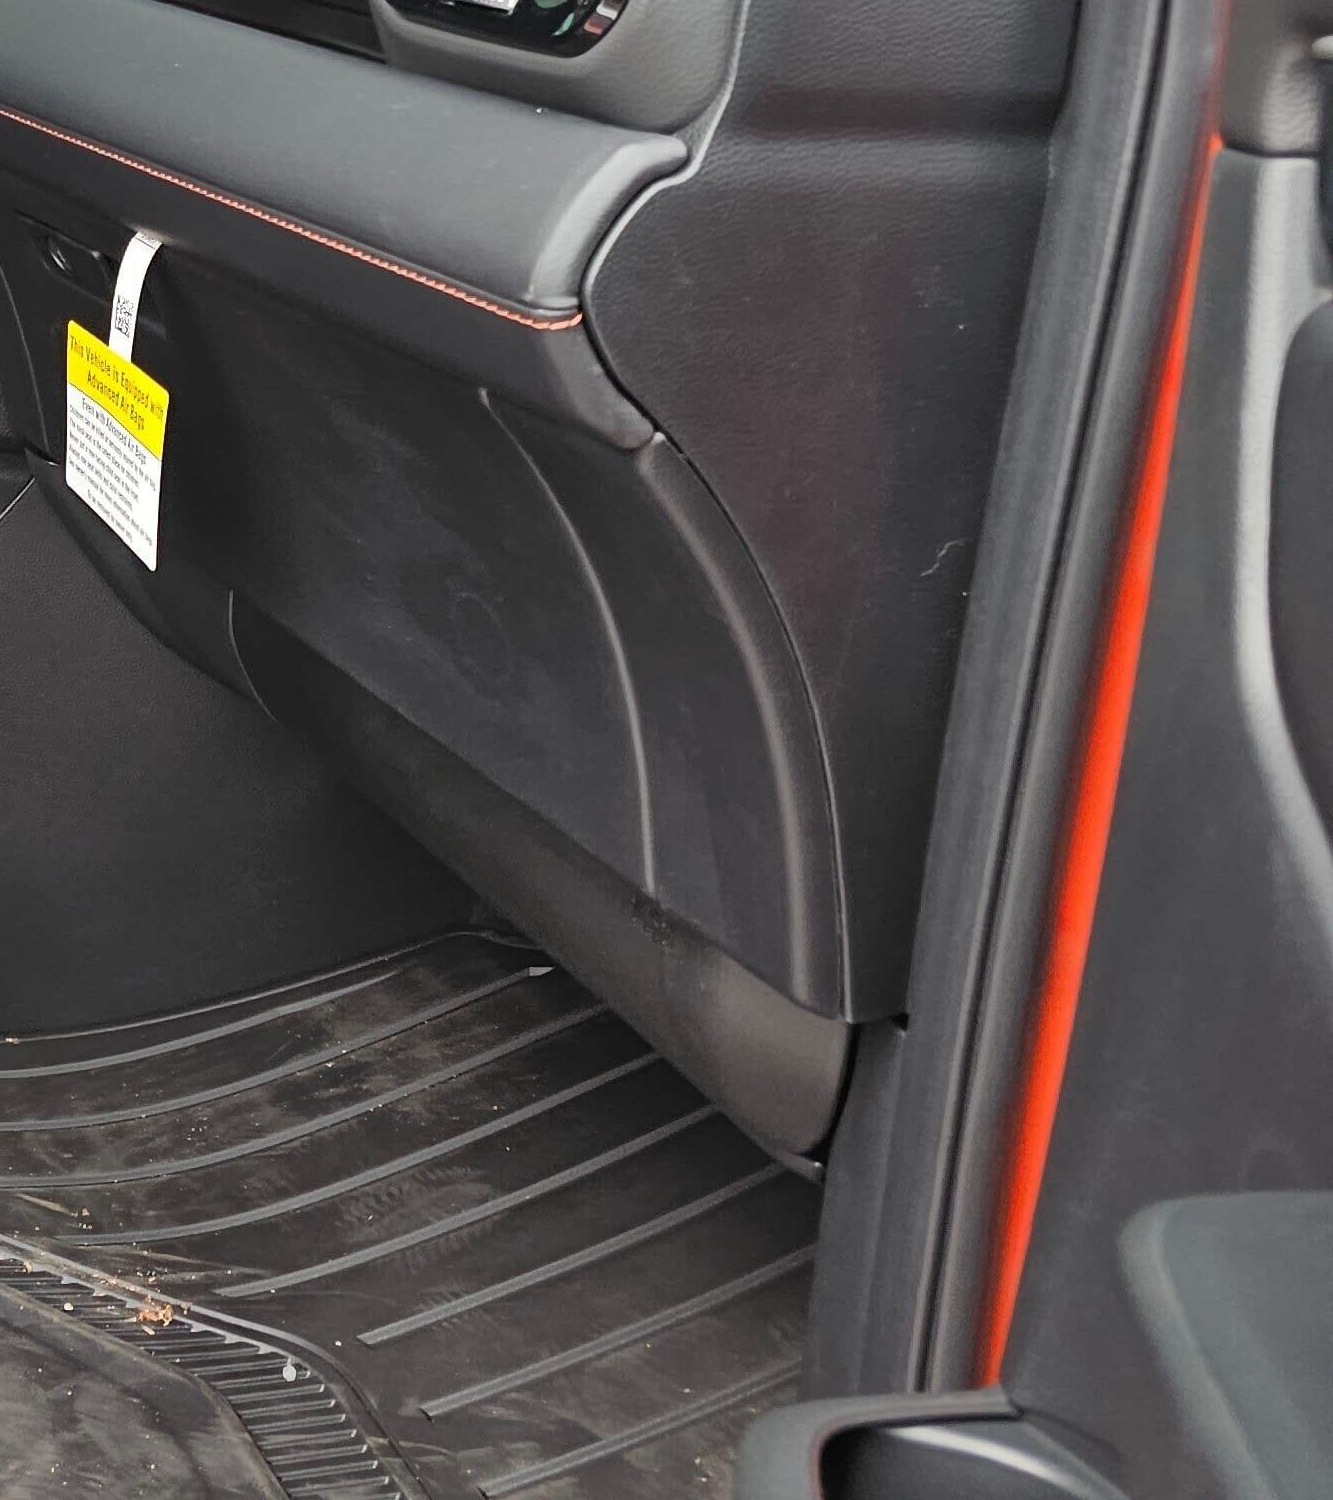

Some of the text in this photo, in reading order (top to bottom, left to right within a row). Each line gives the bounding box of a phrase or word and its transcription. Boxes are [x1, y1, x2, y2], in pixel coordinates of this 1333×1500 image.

[70, 335, 84, 357] This
[86, 346, 110, 377] Vehicle
[121, 372, 149, 409] Equipped
[87, 370, 144, 431] Advanced Air Bags
